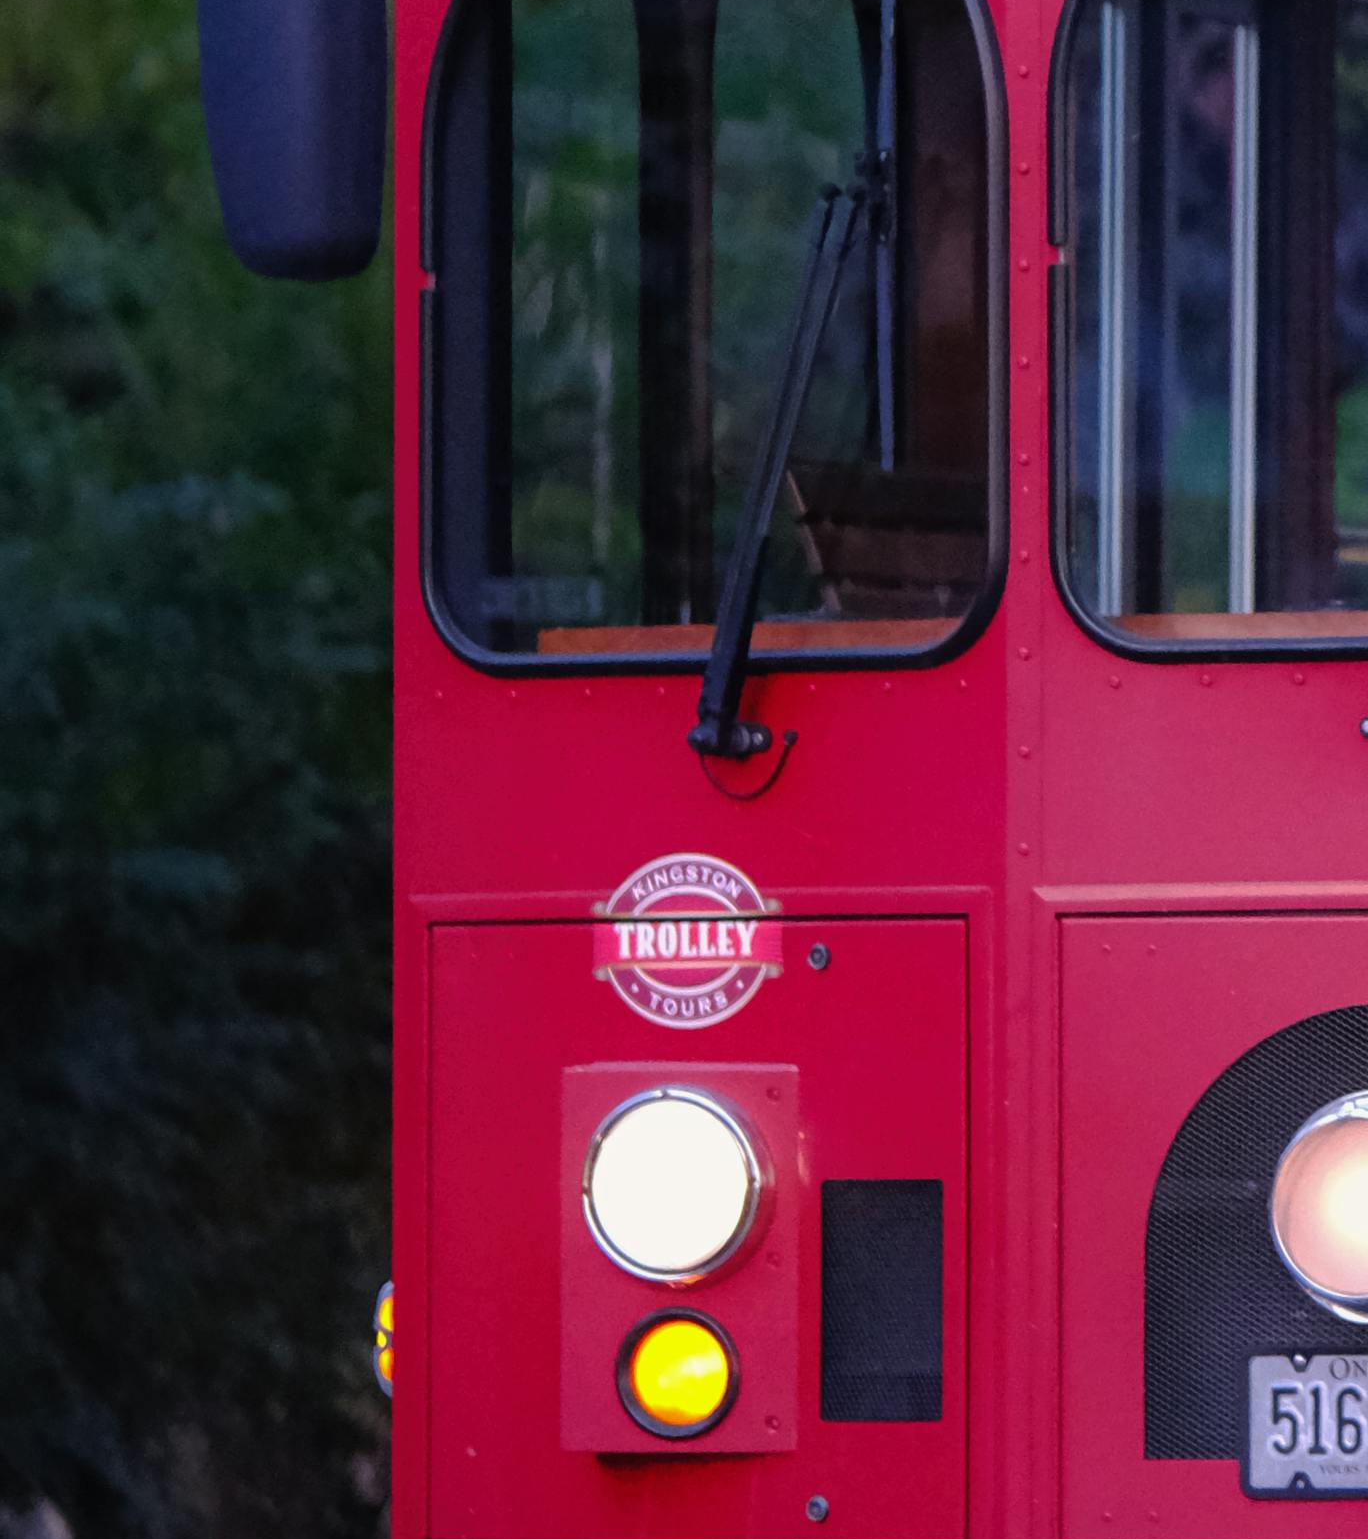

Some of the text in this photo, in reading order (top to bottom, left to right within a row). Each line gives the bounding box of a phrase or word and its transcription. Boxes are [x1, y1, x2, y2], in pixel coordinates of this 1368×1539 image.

[631, 864, 743, 901] KINGSTON
[614, 920, 758, 959] TROLLEY
[650, 989, 729, 1017] TOURS
[1270, 1385, 1367, 1455] 516
